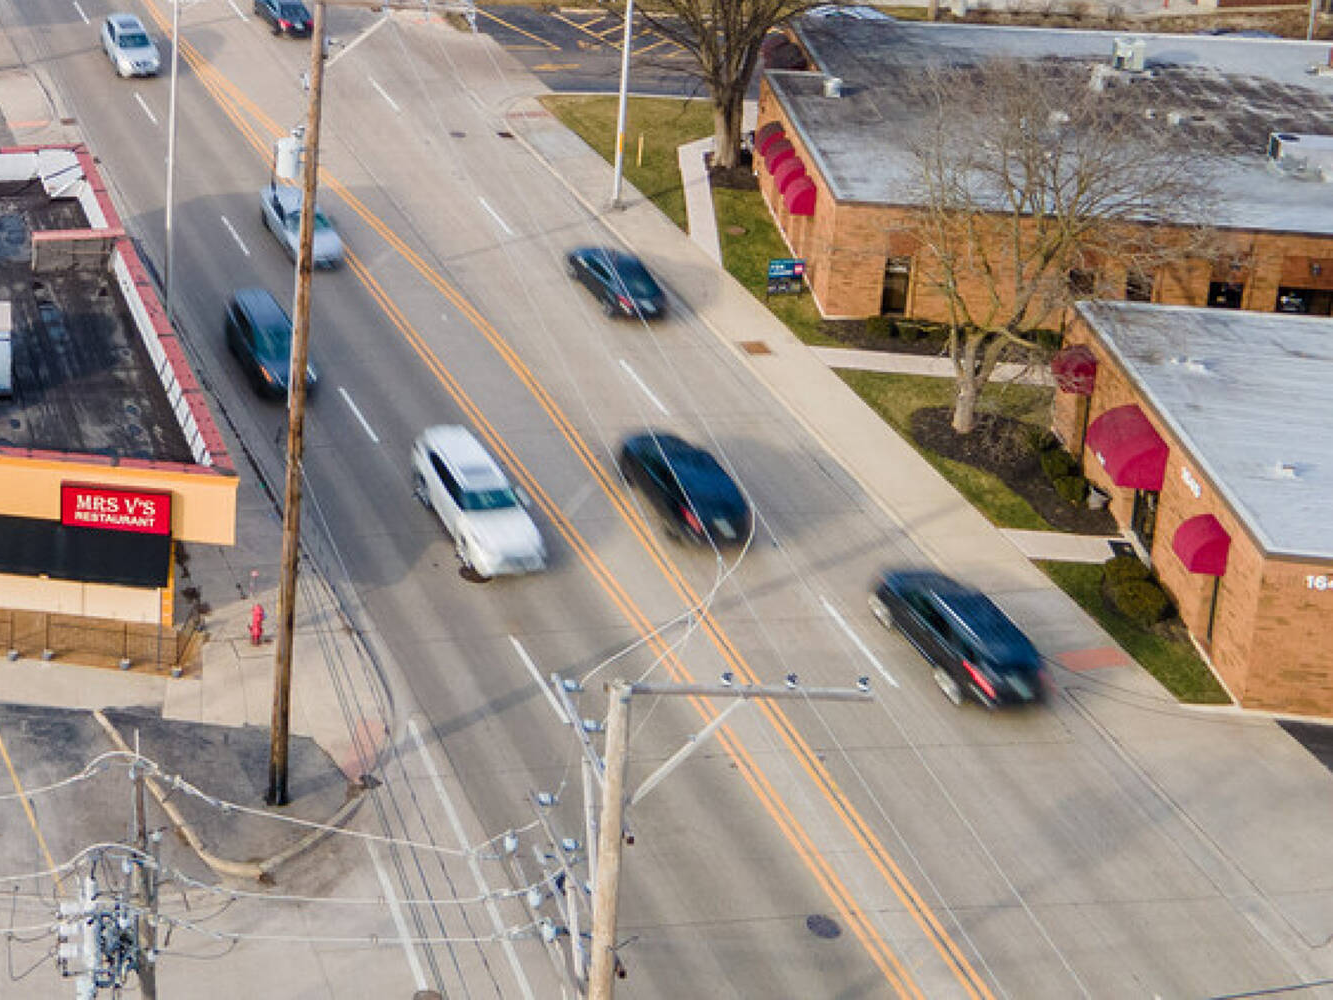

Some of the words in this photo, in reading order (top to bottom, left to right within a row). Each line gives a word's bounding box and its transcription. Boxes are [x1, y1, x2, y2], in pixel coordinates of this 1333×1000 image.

[76, 495, 119, 512] MRS
[74, 511, 155, 526] RESTAURANT
[1306, 575, 1333, 591] 16
